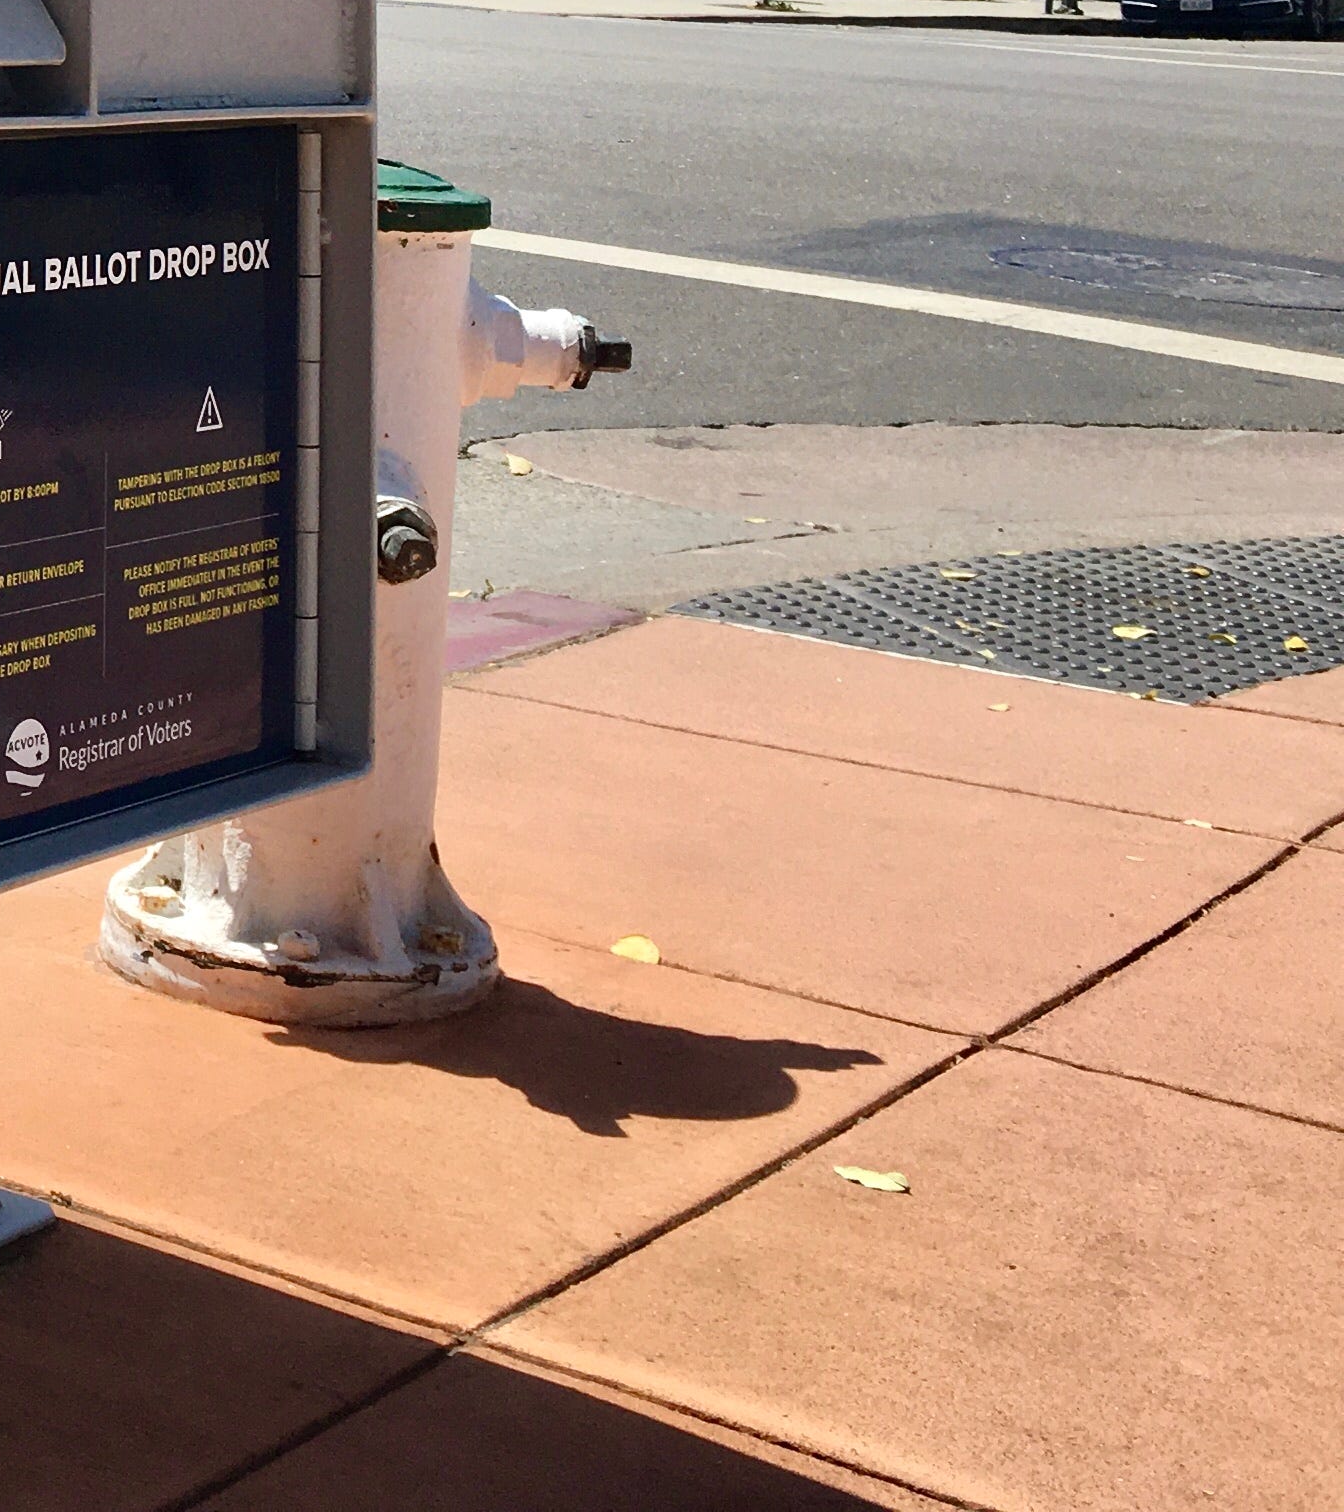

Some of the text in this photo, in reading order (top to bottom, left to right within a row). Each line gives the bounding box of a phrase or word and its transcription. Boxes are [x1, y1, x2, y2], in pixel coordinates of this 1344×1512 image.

[45, 250, 141, 291] BALLOT
[149, 244, 215, 280] DROP
[223, 238, 269, 273] BOX
[13, 487, 25, 501] BY
[27, 481, 58, 498] 8:00PM
[118, 451, 280, 490] TAMPERING WITH THE DROP BOX IS A FELONY
[59, 692, 193, 737] ALAMEDA COUNTY
[7, 732, 46, 754] ACVOTE
[59, 719, 191, 770] Registrar of Voters
